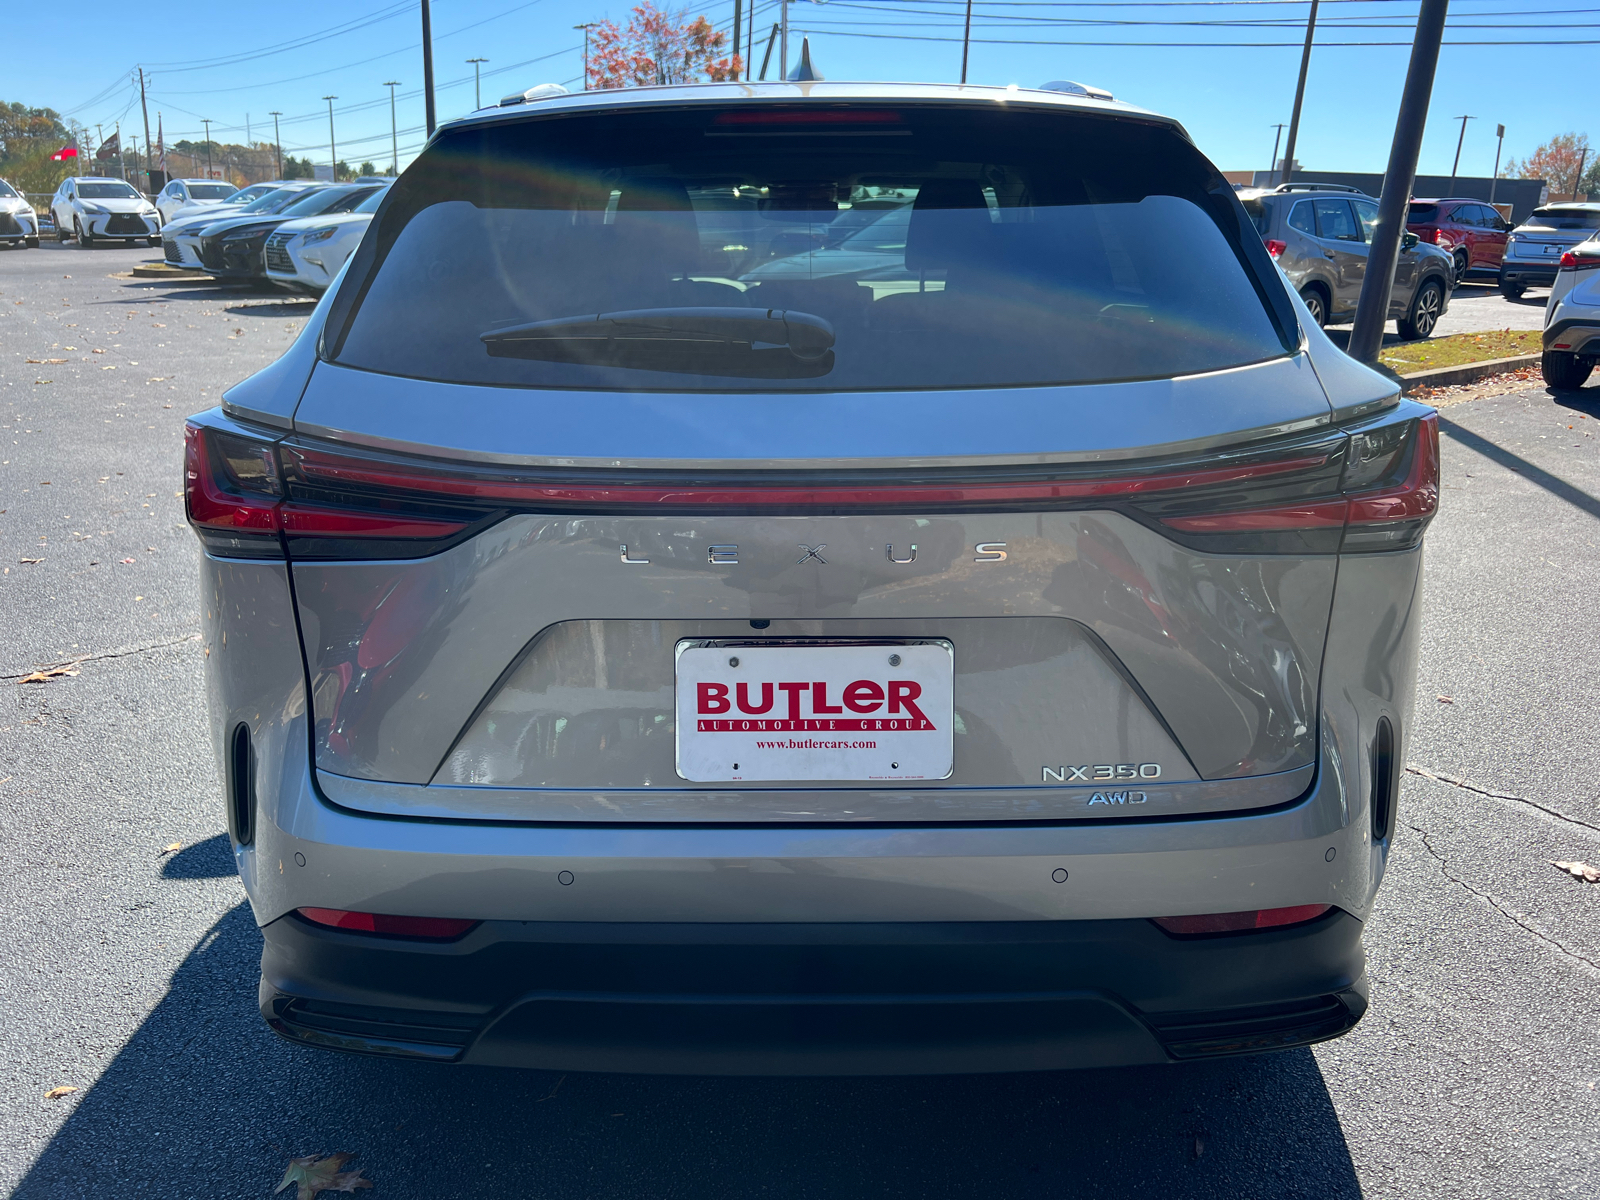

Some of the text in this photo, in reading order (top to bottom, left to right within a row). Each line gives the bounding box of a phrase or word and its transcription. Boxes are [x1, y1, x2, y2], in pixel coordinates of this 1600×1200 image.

[619, 541, 1008, 565] LEXUS
[698, 719, 928, 731] AUTOMOTIVE GROUP
[756, 739, 877, 749] www.butlercars.com
[1086, 789, 1148, 806] AWD
